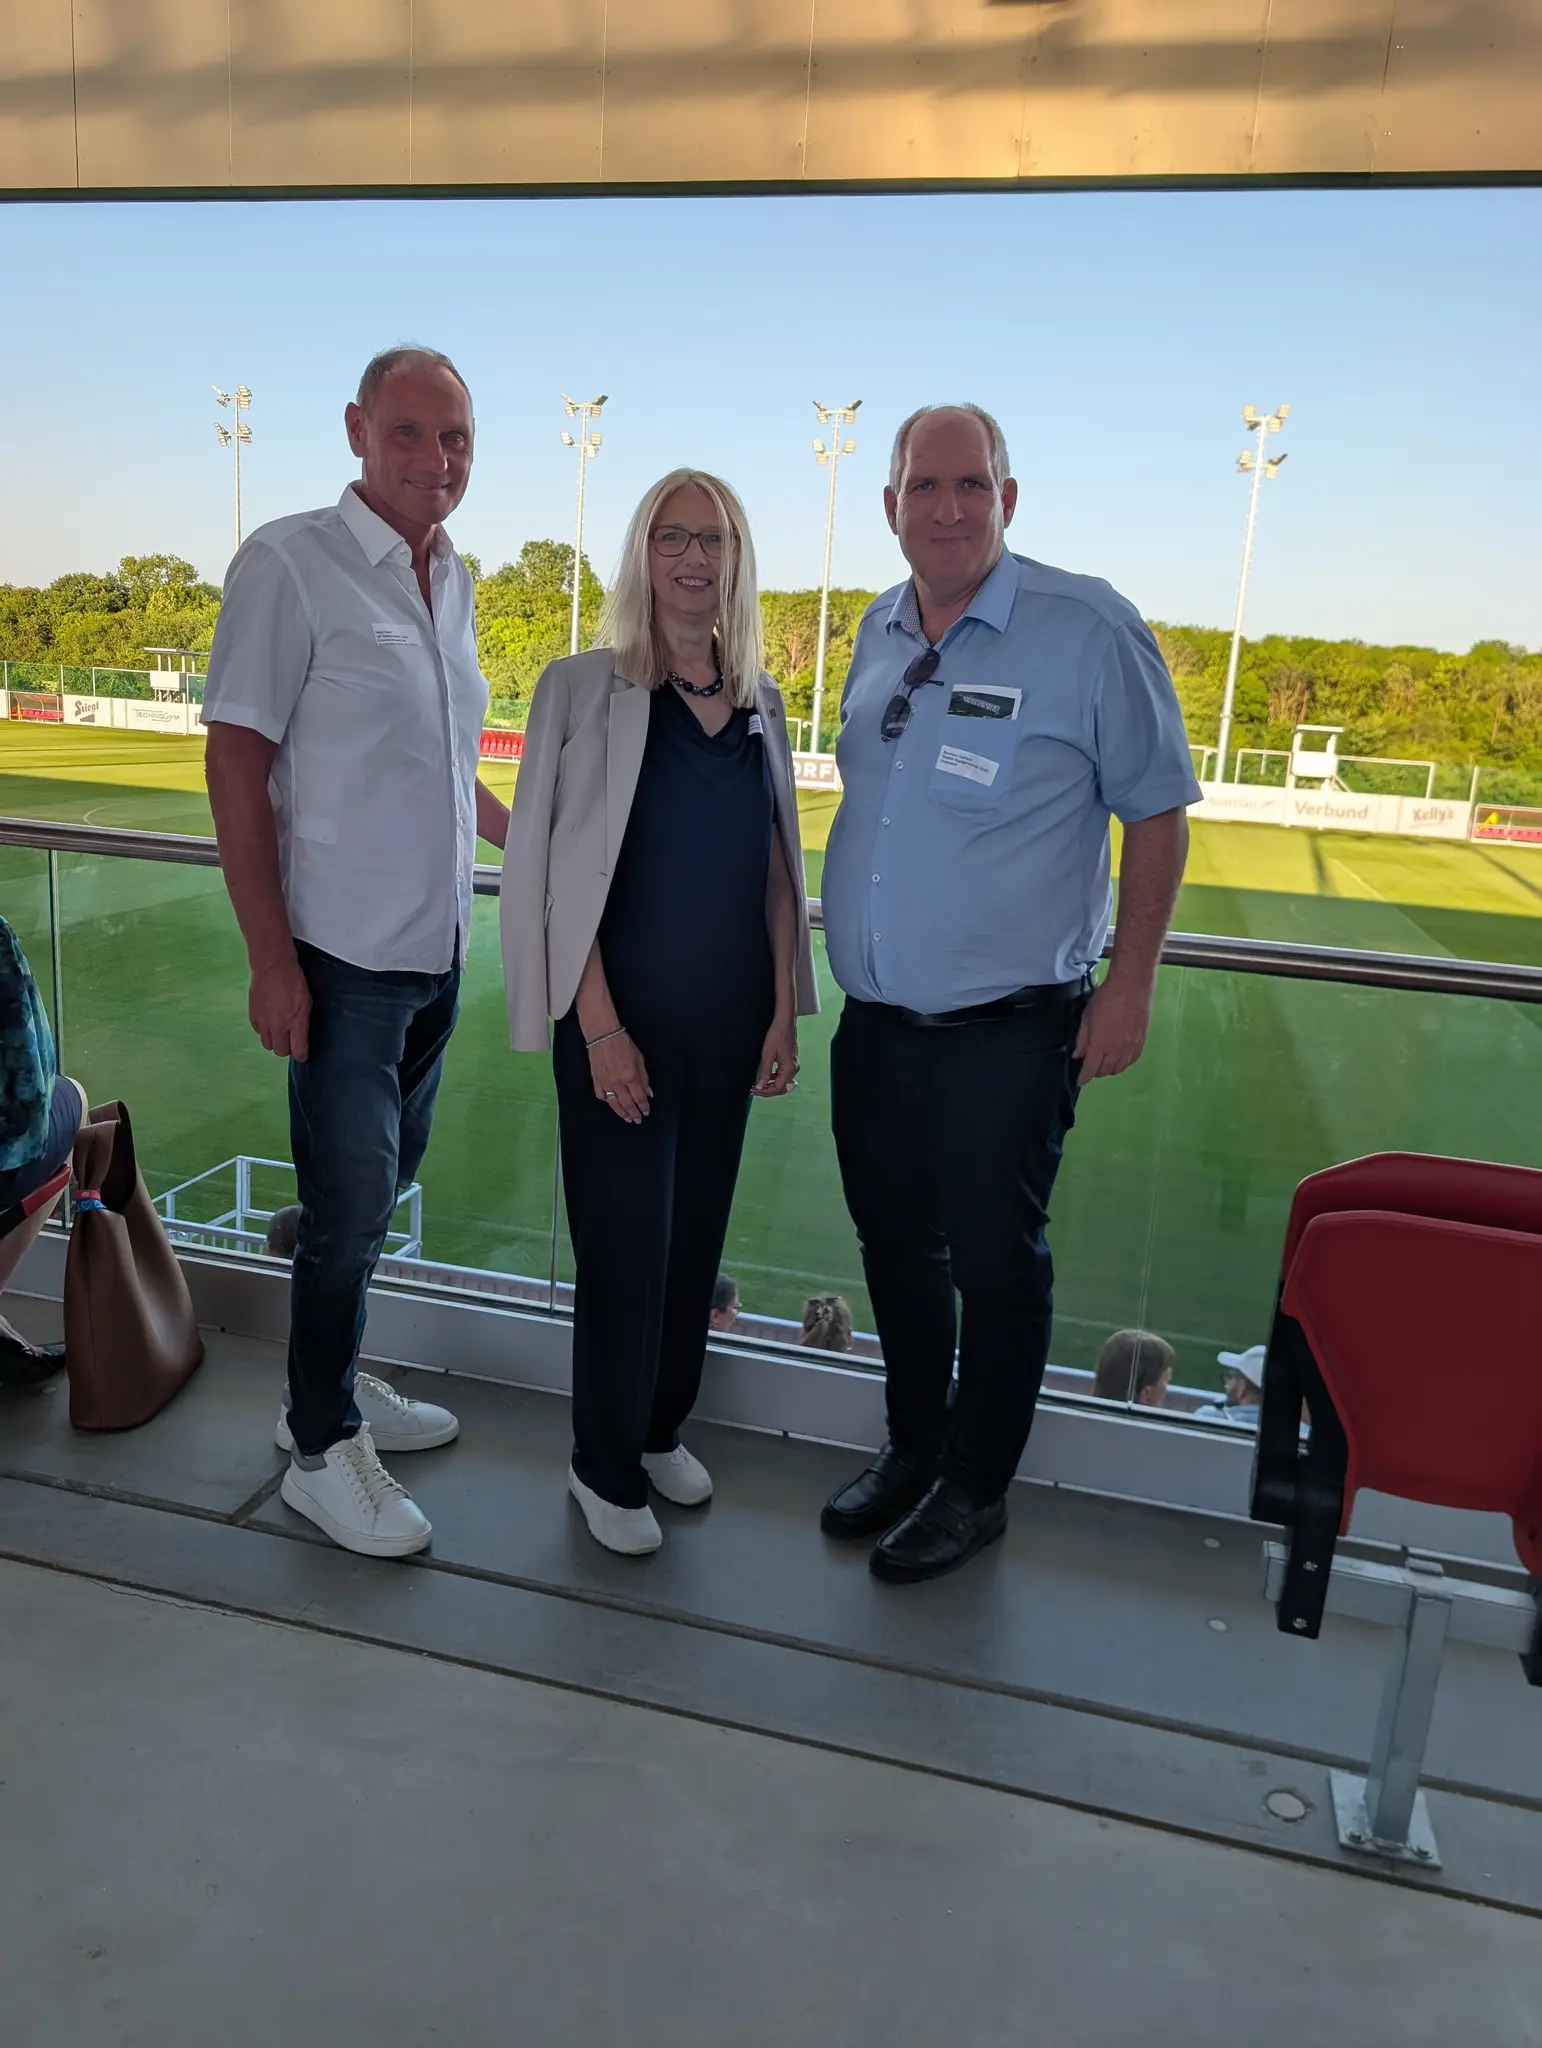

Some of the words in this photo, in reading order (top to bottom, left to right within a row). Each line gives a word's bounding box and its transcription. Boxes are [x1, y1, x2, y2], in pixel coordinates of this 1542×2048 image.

[75, 699, 100, 717] Stiegl
[1295, 800, 1368, 819] Verbund
[1413, 805, 1454, 822] Kelly's
